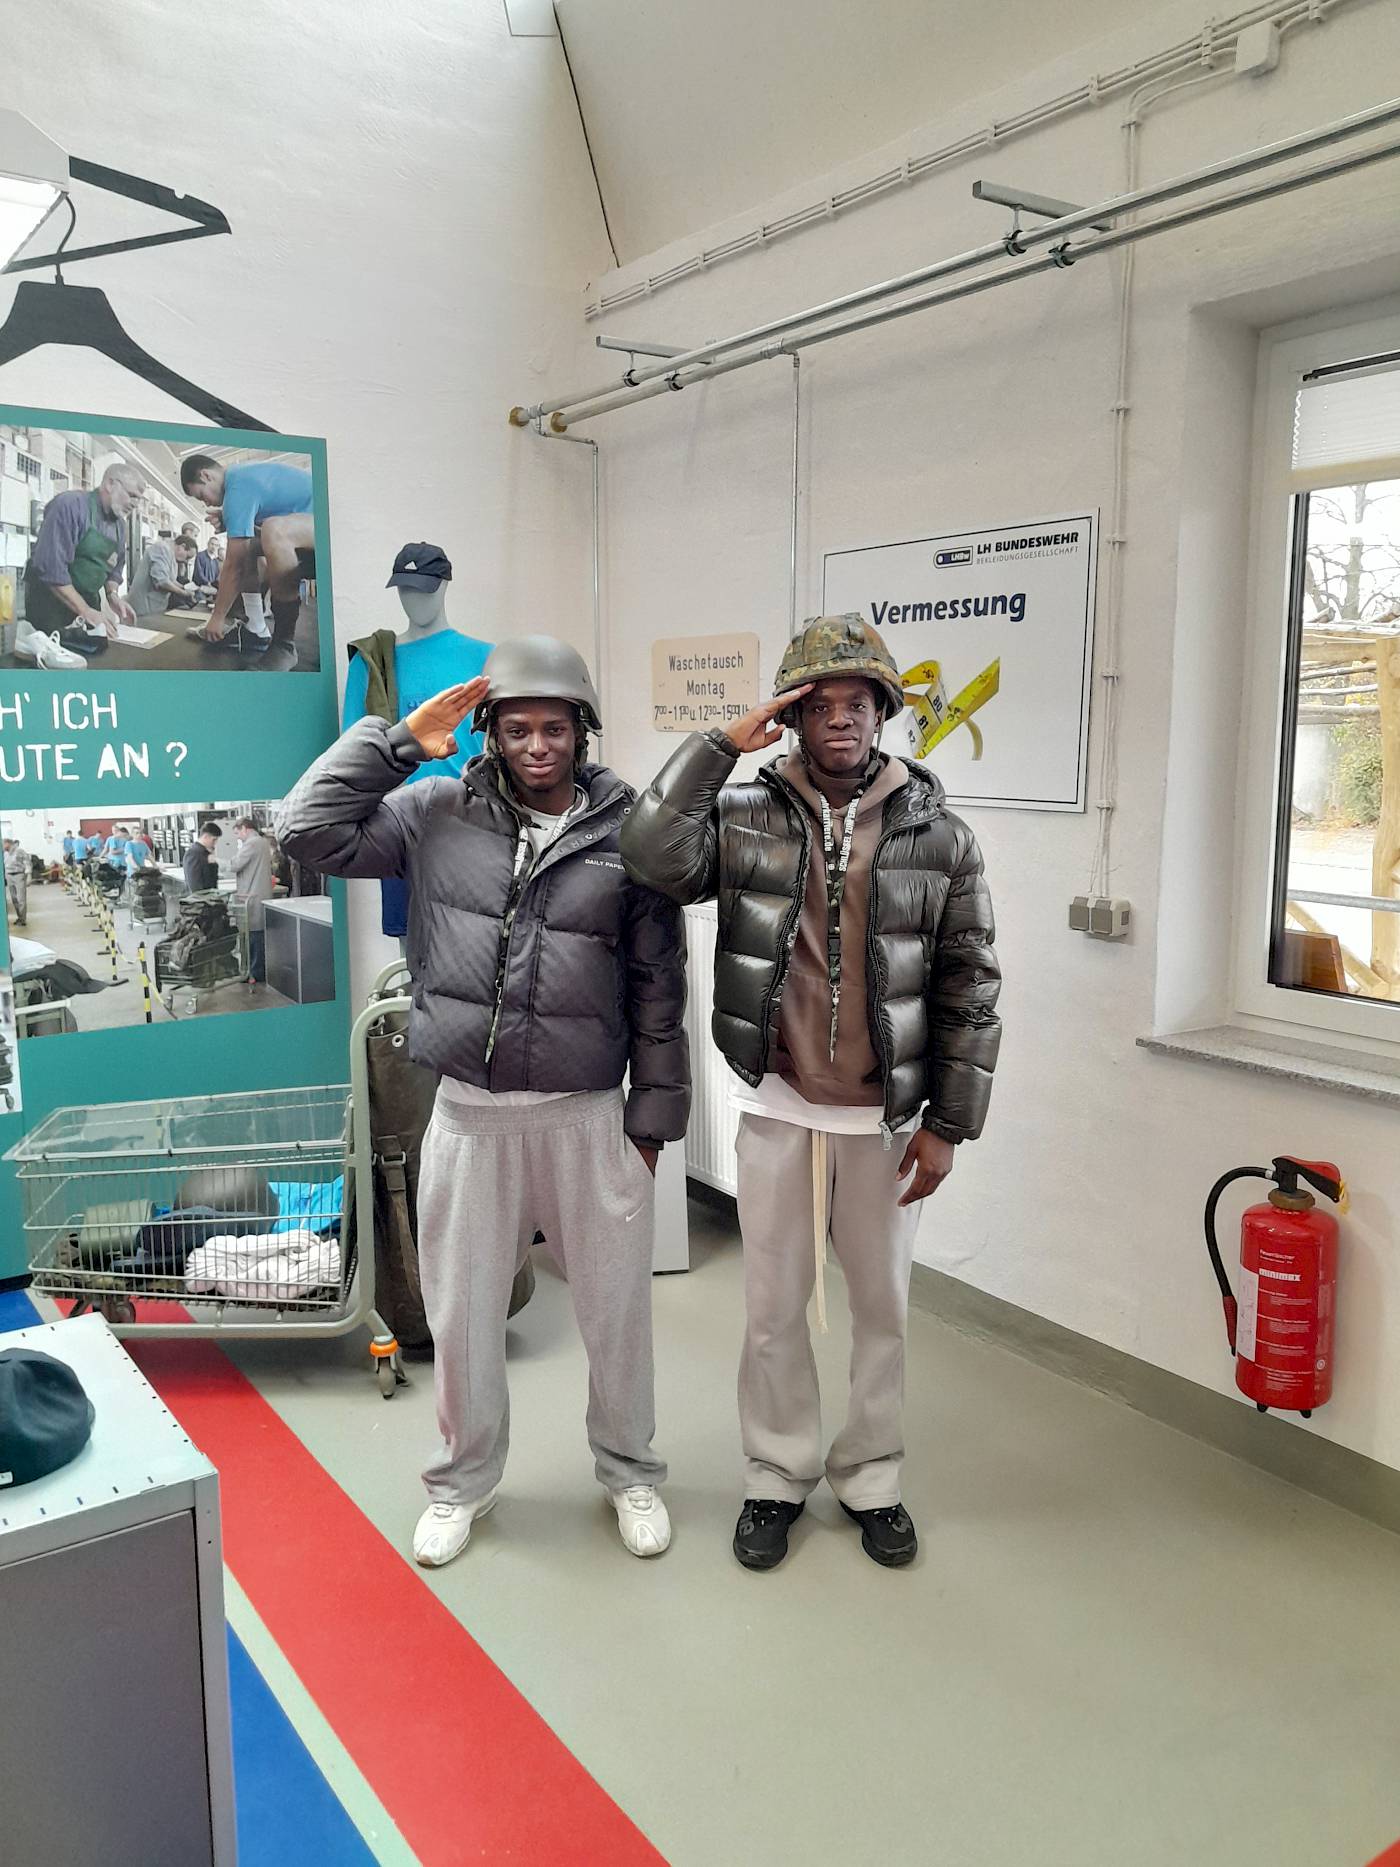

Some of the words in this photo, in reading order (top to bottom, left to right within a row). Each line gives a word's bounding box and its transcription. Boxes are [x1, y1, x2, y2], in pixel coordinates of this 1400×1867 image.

[977, 543, 992, 555] LH
[995, 531, 1079, 552] BUNDESWEHR
[871, 593, 1026, 625] Vermessung
[686, 679, 725, 699] Montag
[52, 692, 118, 730] ICH
[97, 742, 150, 780] AN
[165, 741, 188, 778] ?
[585, 858, 604, 866] DAILY
